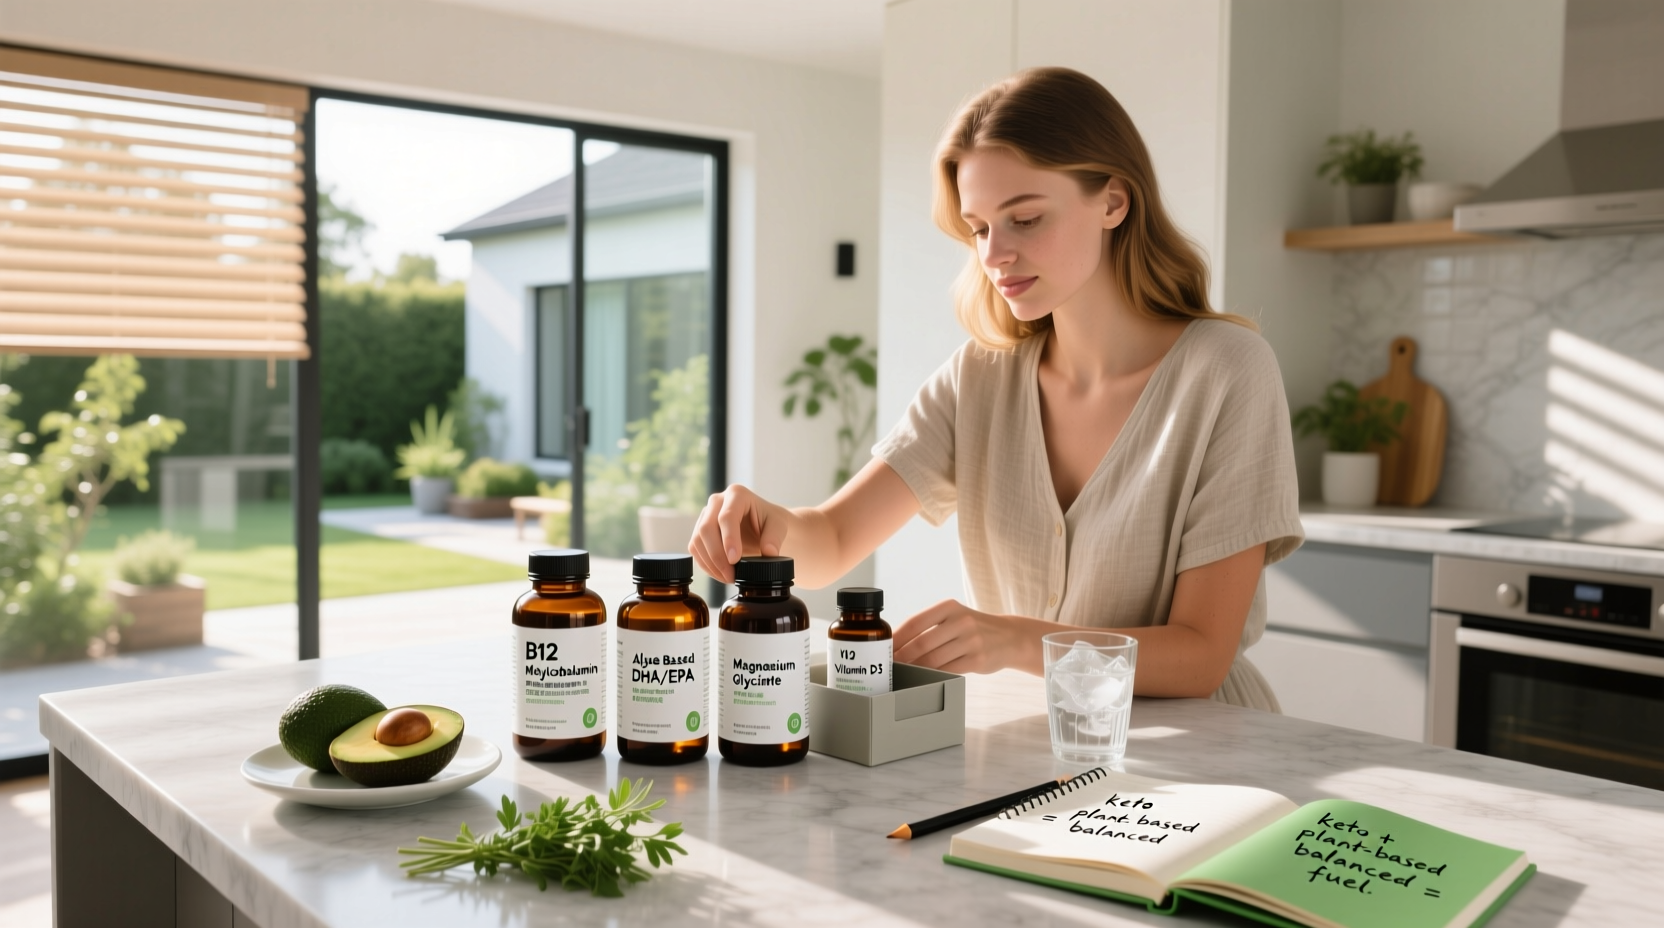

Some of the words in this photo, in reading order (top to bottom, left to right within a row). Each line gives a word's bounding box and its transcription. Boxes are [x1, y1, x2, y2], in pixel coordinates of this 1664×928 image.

[526, 641, 558, 661] B12
[632, 667, 695, 686] DHA/EPA
[1105, 793, 1154, 810] keto
[1069, 820, 1168, 844] balanced
[1137, 814, 1200, 833] based
[1317, 812, 1369, 837] keto
[1294, 842, 1416, 887] balanced
[1295, 829, 1447, 876] plant-based
[1307, 865, 1372, 894] fuel.
